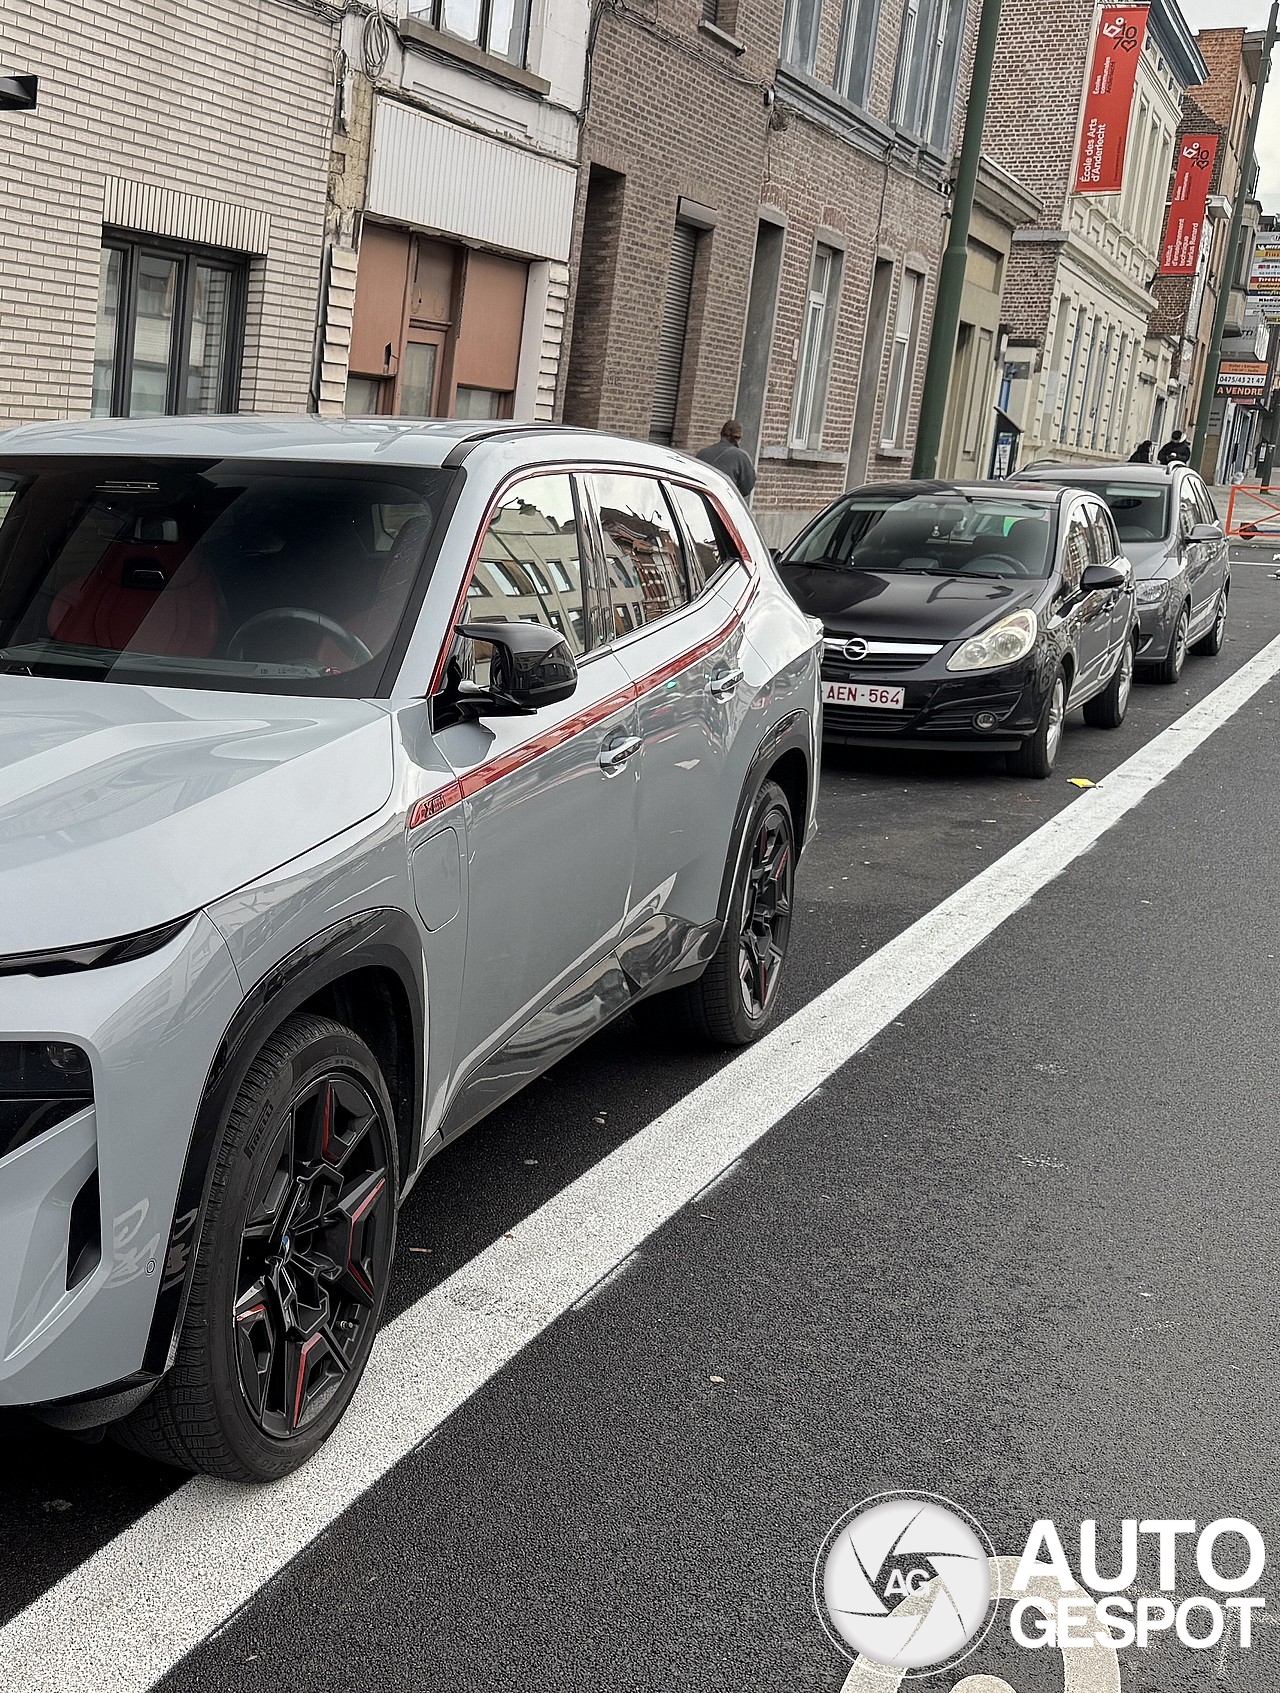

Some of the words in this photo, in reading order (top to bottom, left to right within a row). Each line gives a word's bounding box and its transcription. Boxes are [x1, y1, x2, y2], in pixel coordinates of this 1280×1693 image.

[1087, 118, 1098, 137] Arts
[1085, 139, 1095, 156] des
[1091, 123, 1107, 182] d'Anderlecht
[1079, 157, 1093, 182] École
[1217, 387, 1224, 395] A
[1225, 387, 1263, 396] VENDRE
[243, 1098, 274, 1161] PIRELLI
